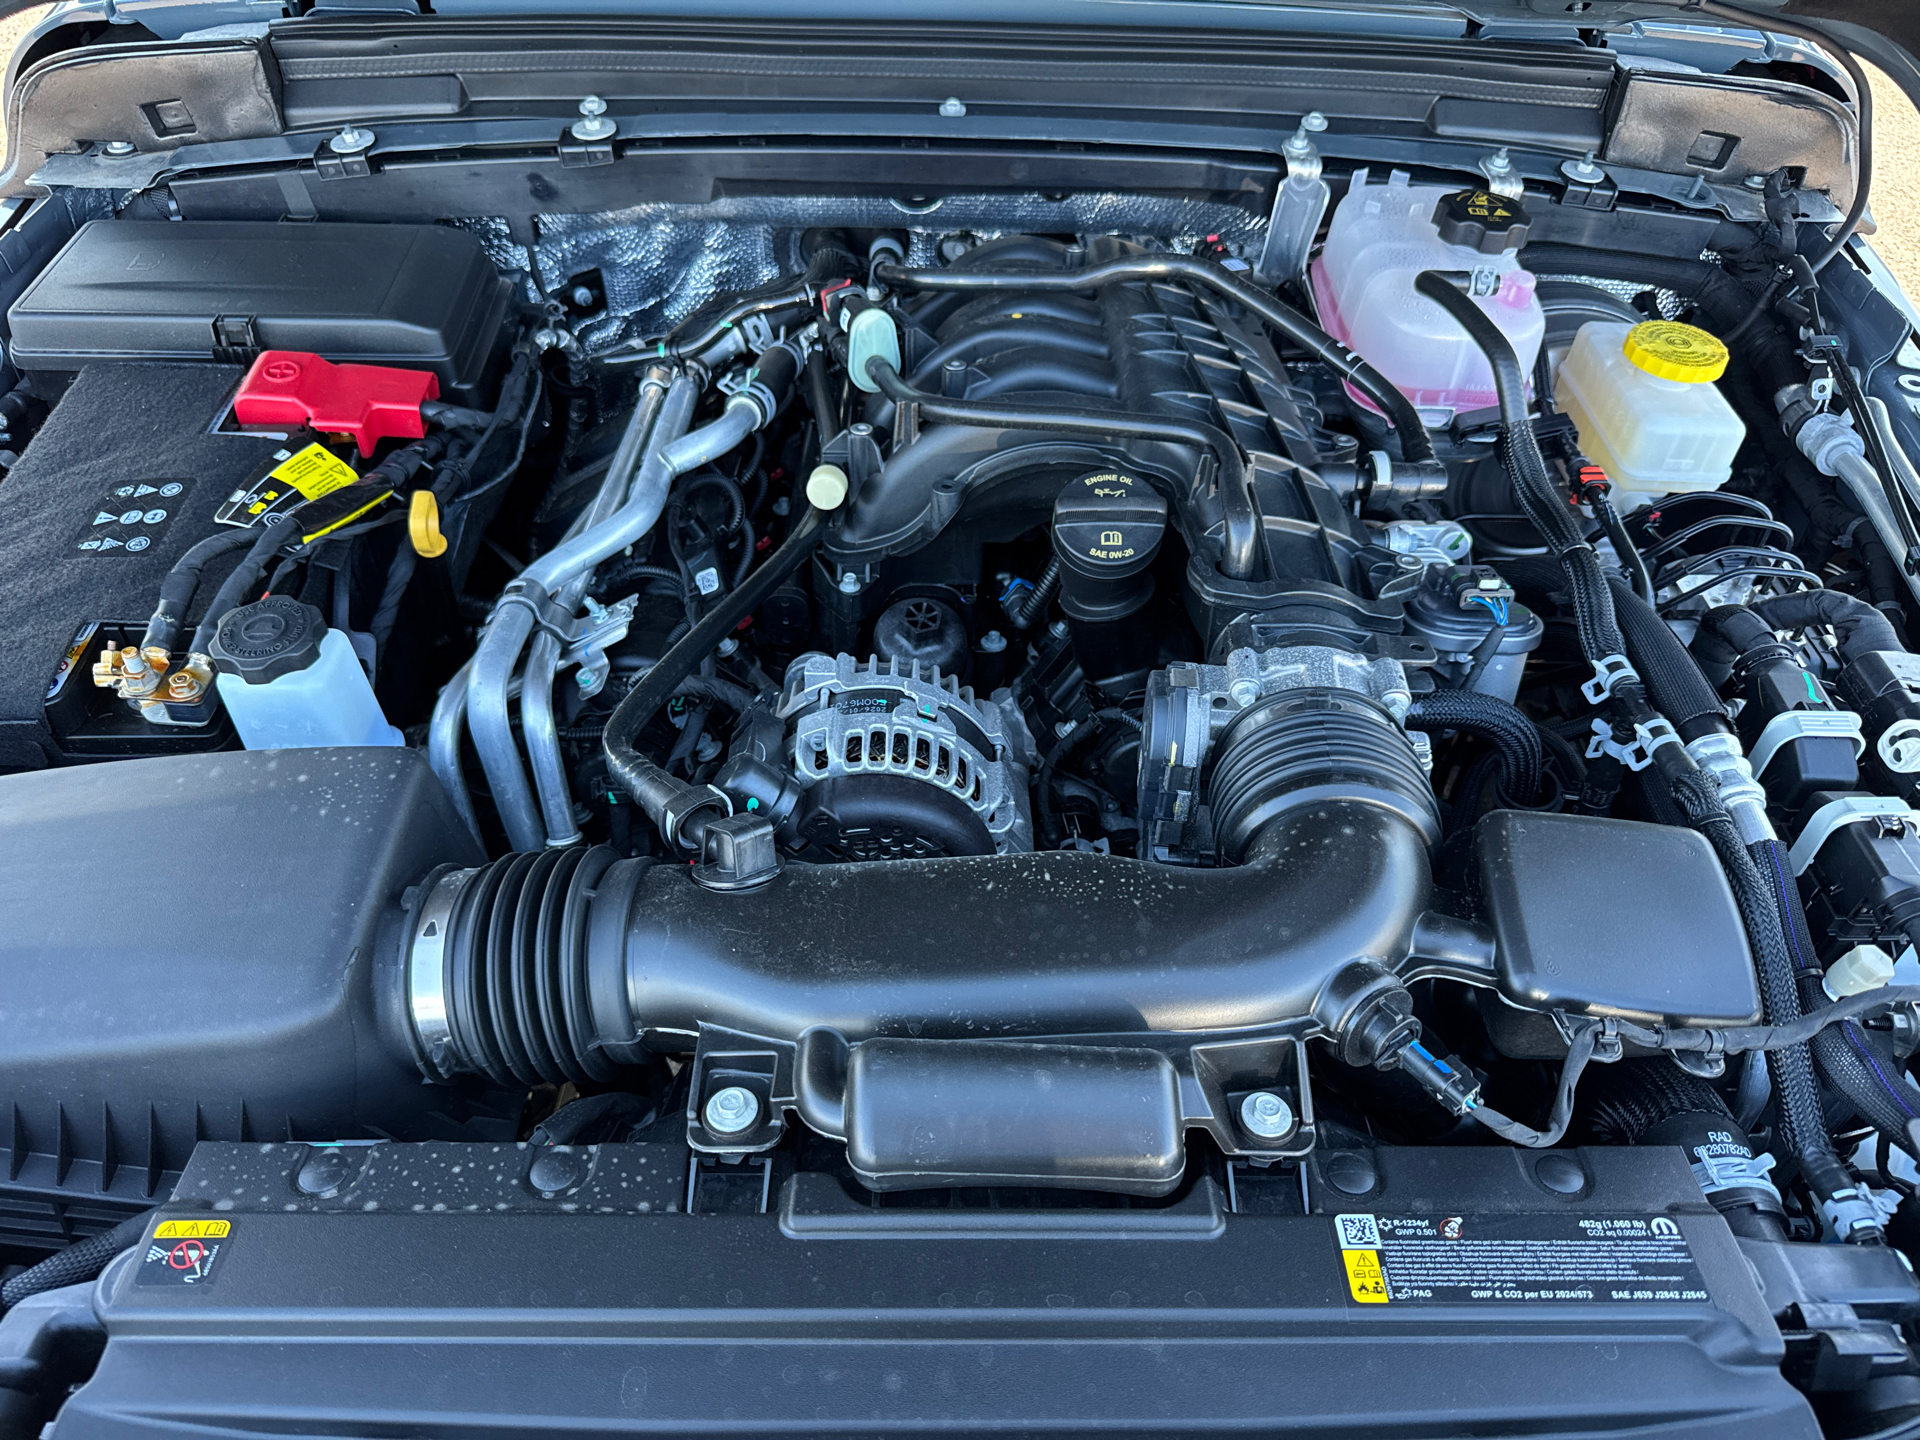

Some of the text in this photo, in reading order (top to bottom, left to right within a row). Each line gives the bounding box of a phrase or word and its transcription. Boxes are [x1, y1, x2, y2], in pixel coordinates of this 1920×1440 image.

[1084, 474, 1133, 486] ENGINE OIL
[1089, 548, 1134, 559] SAE 0W-20
[236, 600, 303, 618] USE APPROVED
[1707, 1131, 1732, 1143] RAD
[1578, 1219, 1647, 1229] 482g (1.060 lb)
[1395, 1228, 1437, 1236] GWP 0.501
[1586, 1229, 1605, 1237] CO2
[1412, 1289, 1433, 1298] PAG
[1470, 1290, 1594, 1300] GWP & CO2 per EU 2024/573
[1611, 1290, 1631, 1299] SAE
[1632, 1290, 1654, 1299] J639
[1654, 1290, 1681, 1299] J2842
